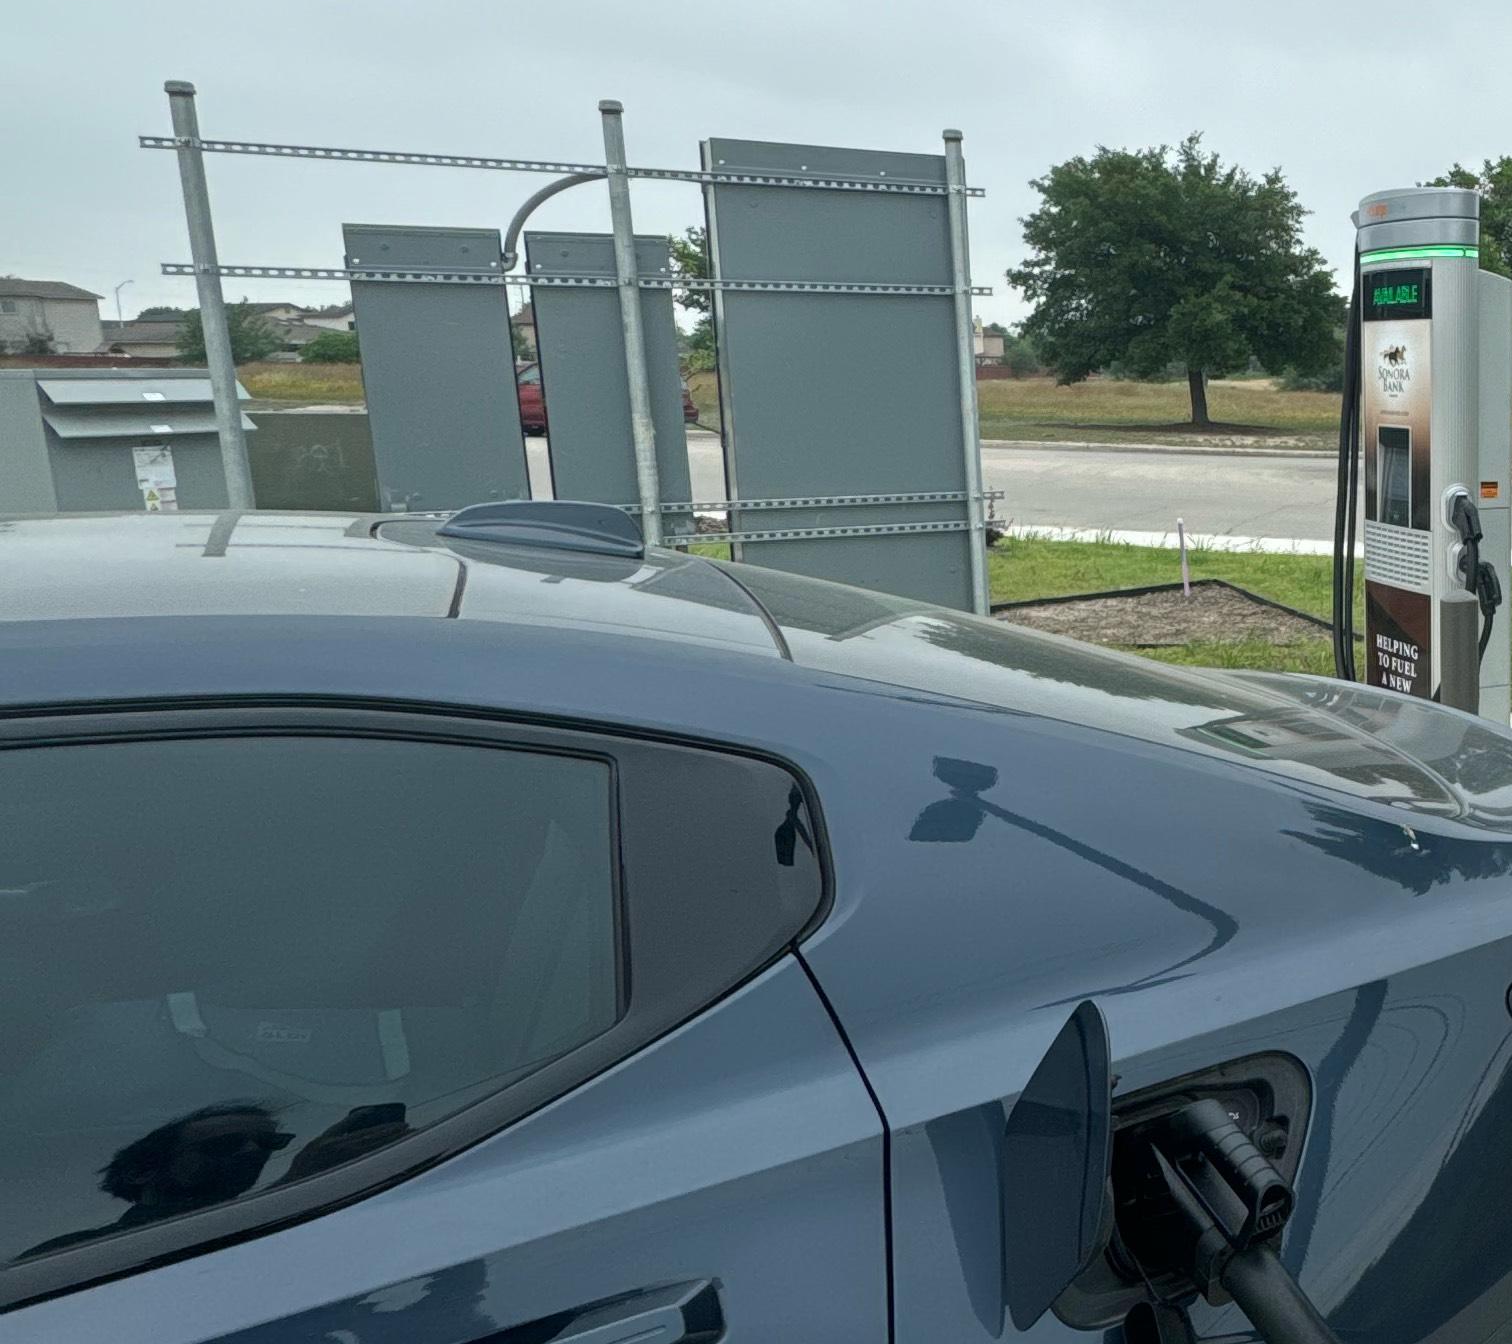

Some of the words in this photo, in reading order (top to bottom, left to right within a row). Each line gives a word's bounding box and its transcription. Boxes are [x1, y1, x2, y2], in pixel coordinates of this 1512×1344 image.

[1373, 285, 1418, 306] AVAILABLE
[1383, 377, 1405, 393] BANK
[1376, 633, 1419, 660] HELPING
[1378, 651, 1390, 668] TO
[1391, 657, 1418, 677] FUEL
[1382, 671, 1388, 685] A
[1389, 673, 1413, 693] NEW
